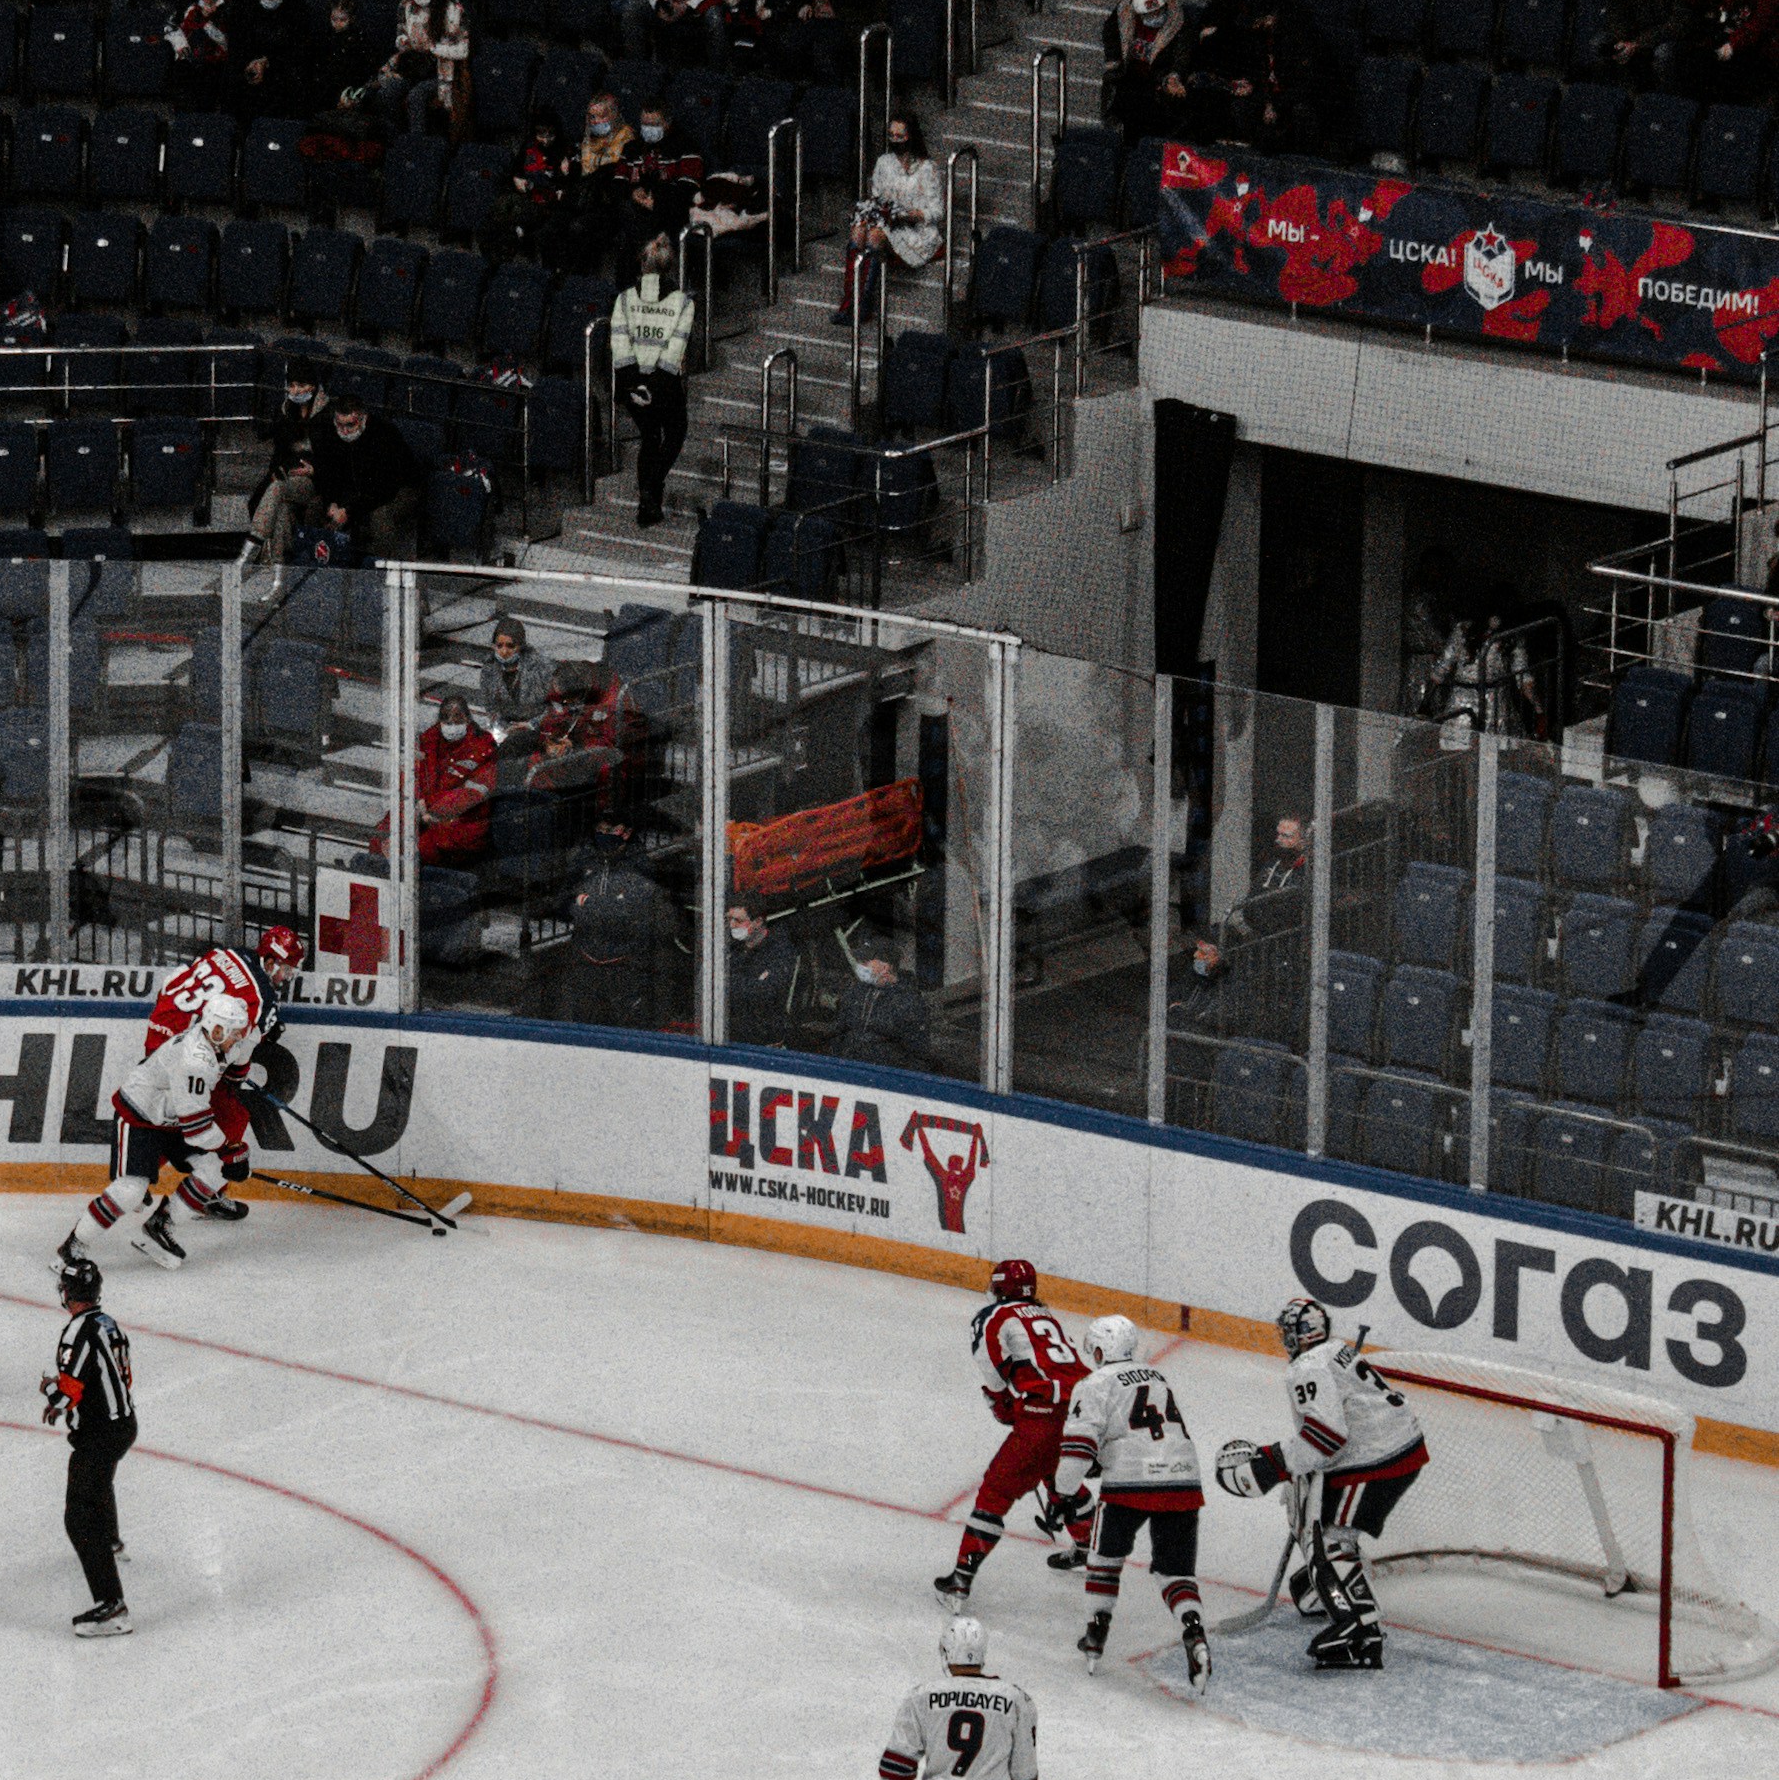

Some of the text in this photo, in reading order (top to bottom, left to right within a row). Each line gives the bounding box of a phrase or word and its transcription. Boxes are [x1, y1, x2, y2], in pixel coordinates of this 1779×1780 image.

[1267, 218, 1305, 243] МЫ
[1389, 238, 1457, 267] ЦСКА!
[1524, 260, 1564, 285] МЫ
[1637, 276, 1760, 316] ПОБЕДИМ!
[14, 968, 153, 998] KHL.RU
[188, 1076, 205, 1095] 10
[709, 1077, 887, 1184] ЦСКА
[709, 1169, 890, 1218] WWW.CSKA-HOCKEY.RU
[1655, 1201, 1779, 1252] KHL.RU
[1295, 1381, 1317, 1404] 39
[930, 1691, 1013, 1714] POPUGAYEV
[947, 1710, 985, 1777] 9
